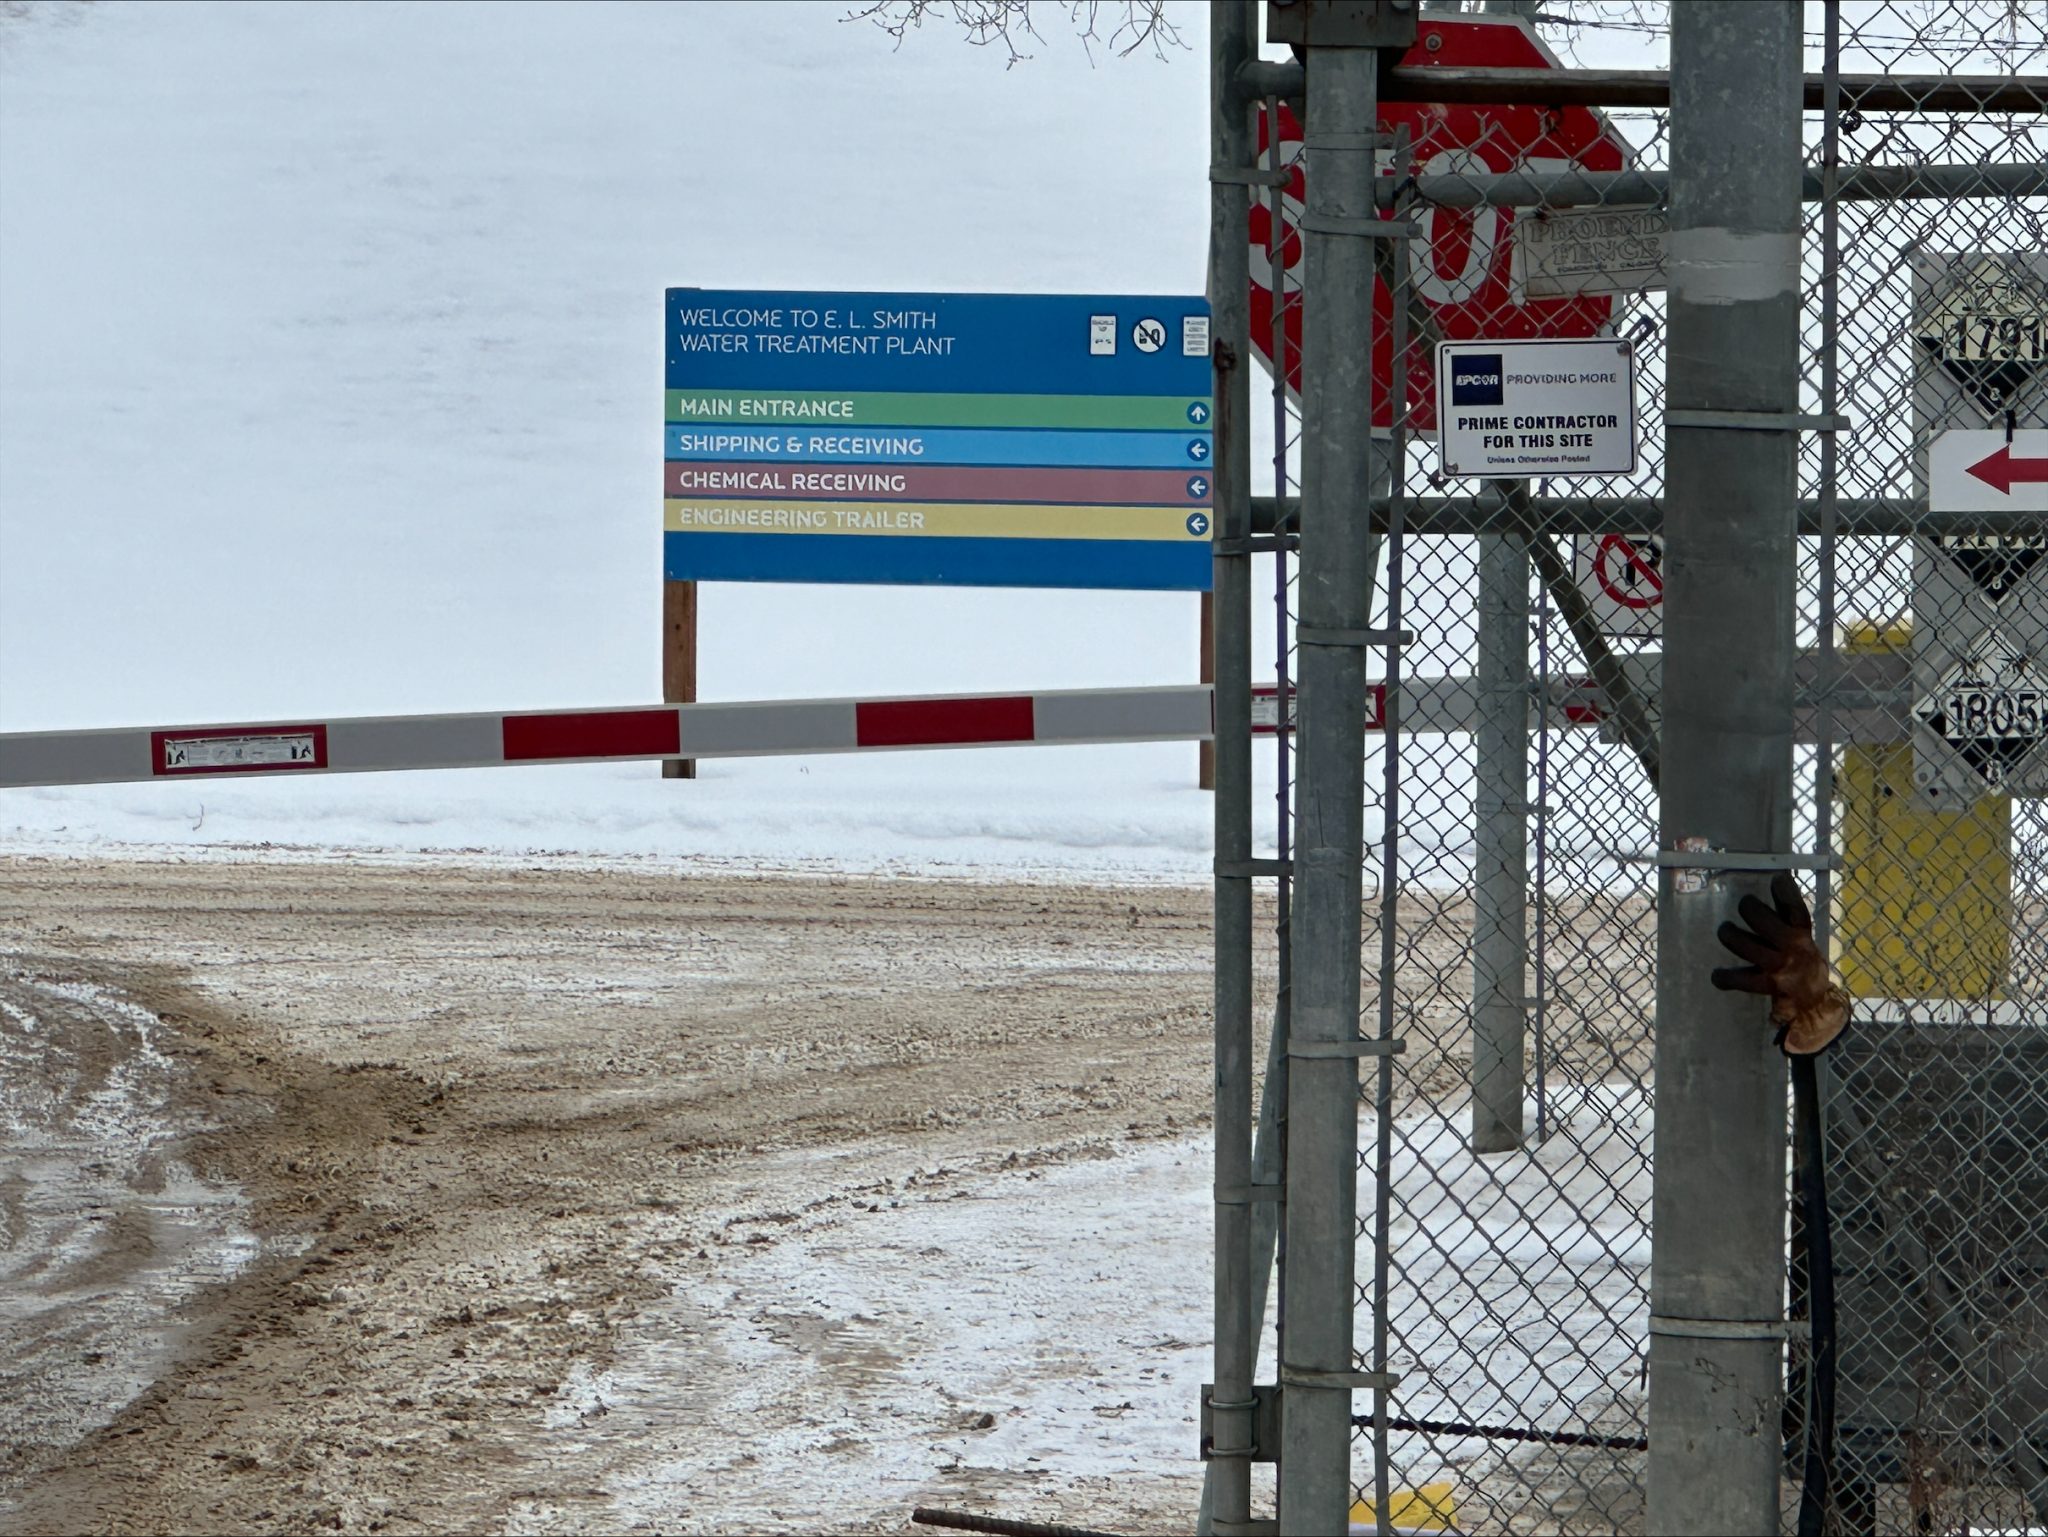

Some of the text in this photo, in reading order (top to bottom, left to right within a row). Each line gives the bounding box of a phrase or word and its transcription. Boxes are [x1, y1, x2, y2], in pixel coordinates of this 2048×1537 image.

[680, 308, 936, 329] WELCOME TO E. L. SMITH
[680, 333, 956, 355] WATER TREATMENT PLANT
[1506, 374, 1577, 385] PROVIDING
[1579, 373, 1617, 384] MORE
[680, 398, 854, 417] MAIN ENTRANCE
[1458, 415, 1618, 431] PRIME CONTRACTOR
[680, 435, 924, 455] SHIPPING & RECEIVING
[1483, 433, 1593, 449] FOR THIS SITE
[1487, 455, 1591, 465] Unless Otherwise Posted
[680, 471, 906, 492] CHEMICAL RECEIVING
[680, 508, 925, 529] ENGINEERING TRAILER
[1949, 693, 2038, 736] 1805
